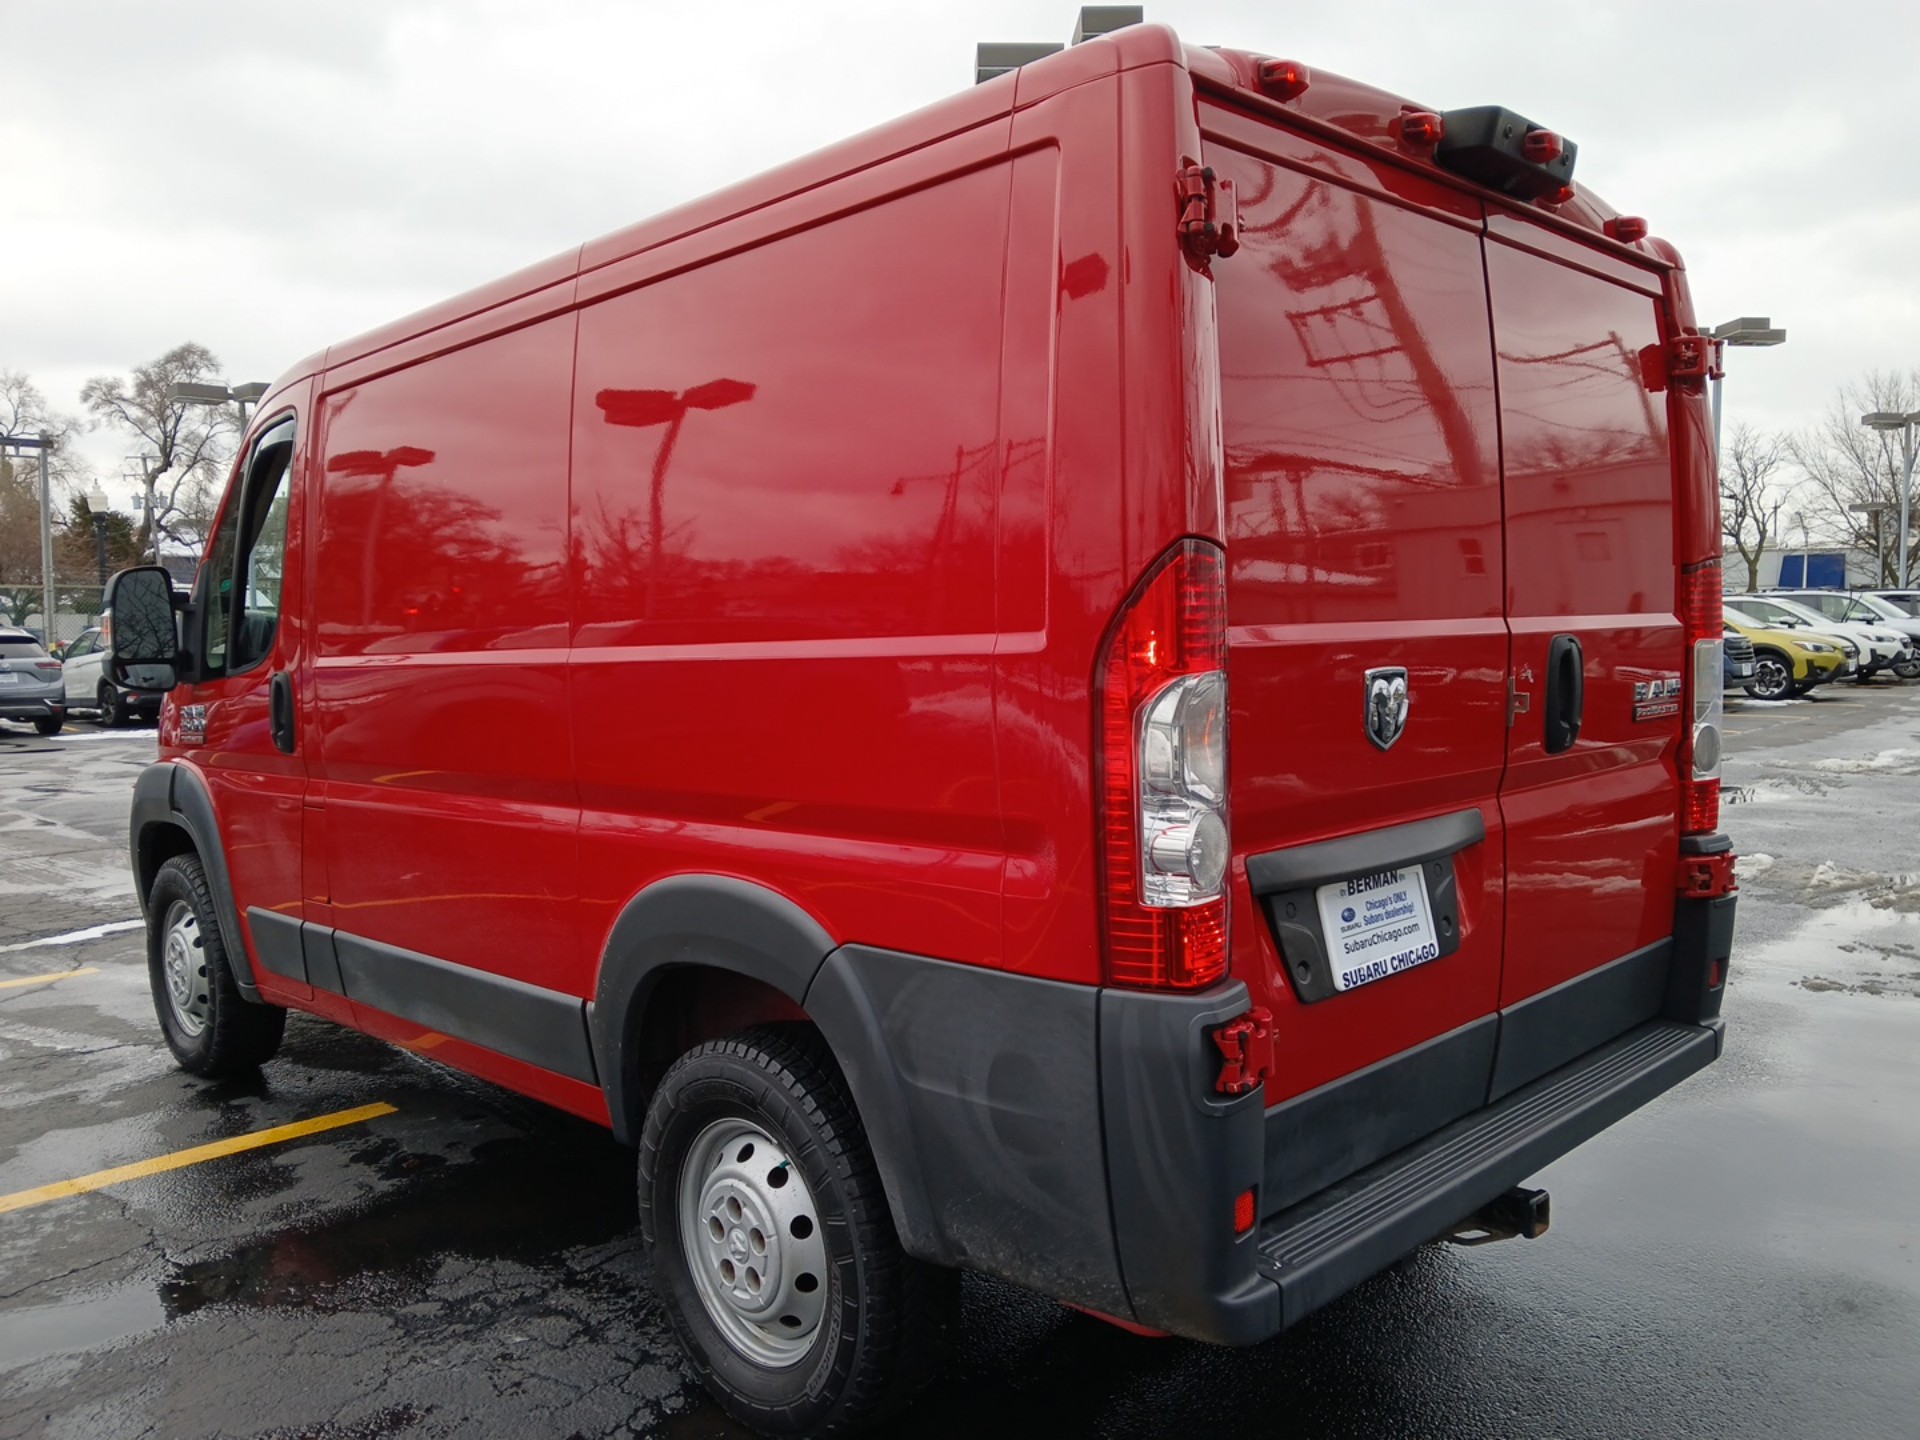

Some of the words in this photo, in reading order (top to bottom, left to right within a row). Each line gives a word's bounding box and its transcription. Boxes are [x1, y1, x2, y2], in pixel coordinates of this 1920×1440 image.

[1347, 870, 1398, 896] BERMAN
[1365, 895, 1393, 912] Chicago's
[1393, 890, 1408, 903] ONLY
[1363, 912, 1385, 926] Subaru
[1343, 922, 1420, 954] SubaruChicago.com
[1342, 959, 1388, 988] SUBARU
[1390, 943, 1436, 970] CHICAGO
